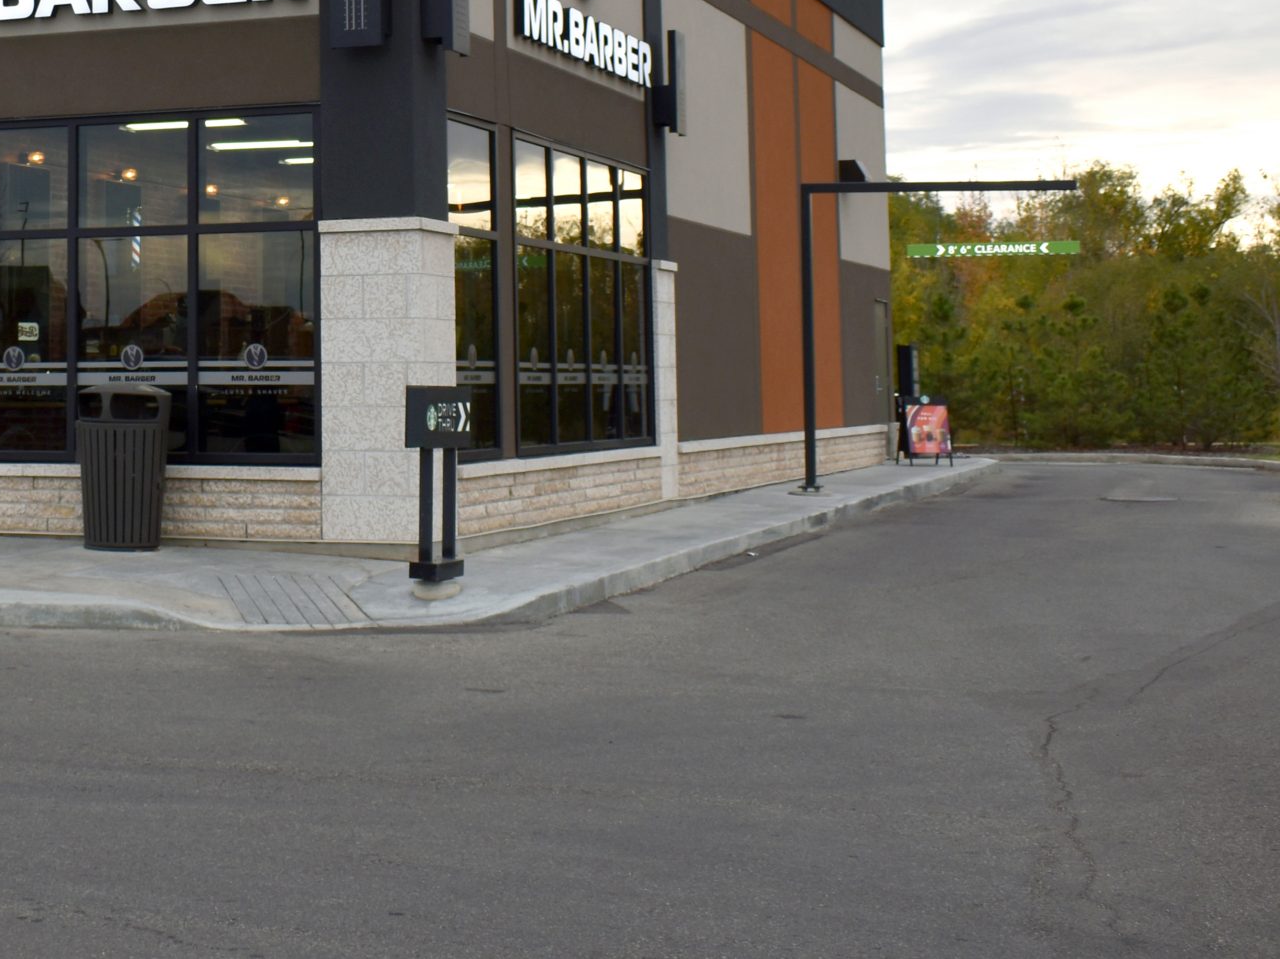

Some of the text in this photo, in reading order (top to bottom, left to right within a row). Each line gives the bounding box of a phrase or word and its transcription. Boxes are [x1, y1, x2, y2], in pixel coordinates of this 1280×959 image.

[974, 243, 1037, 254] CLEARANCE
[437, 402, 457, 417] DRIVE
[437, 418, 456, 432] THRU
